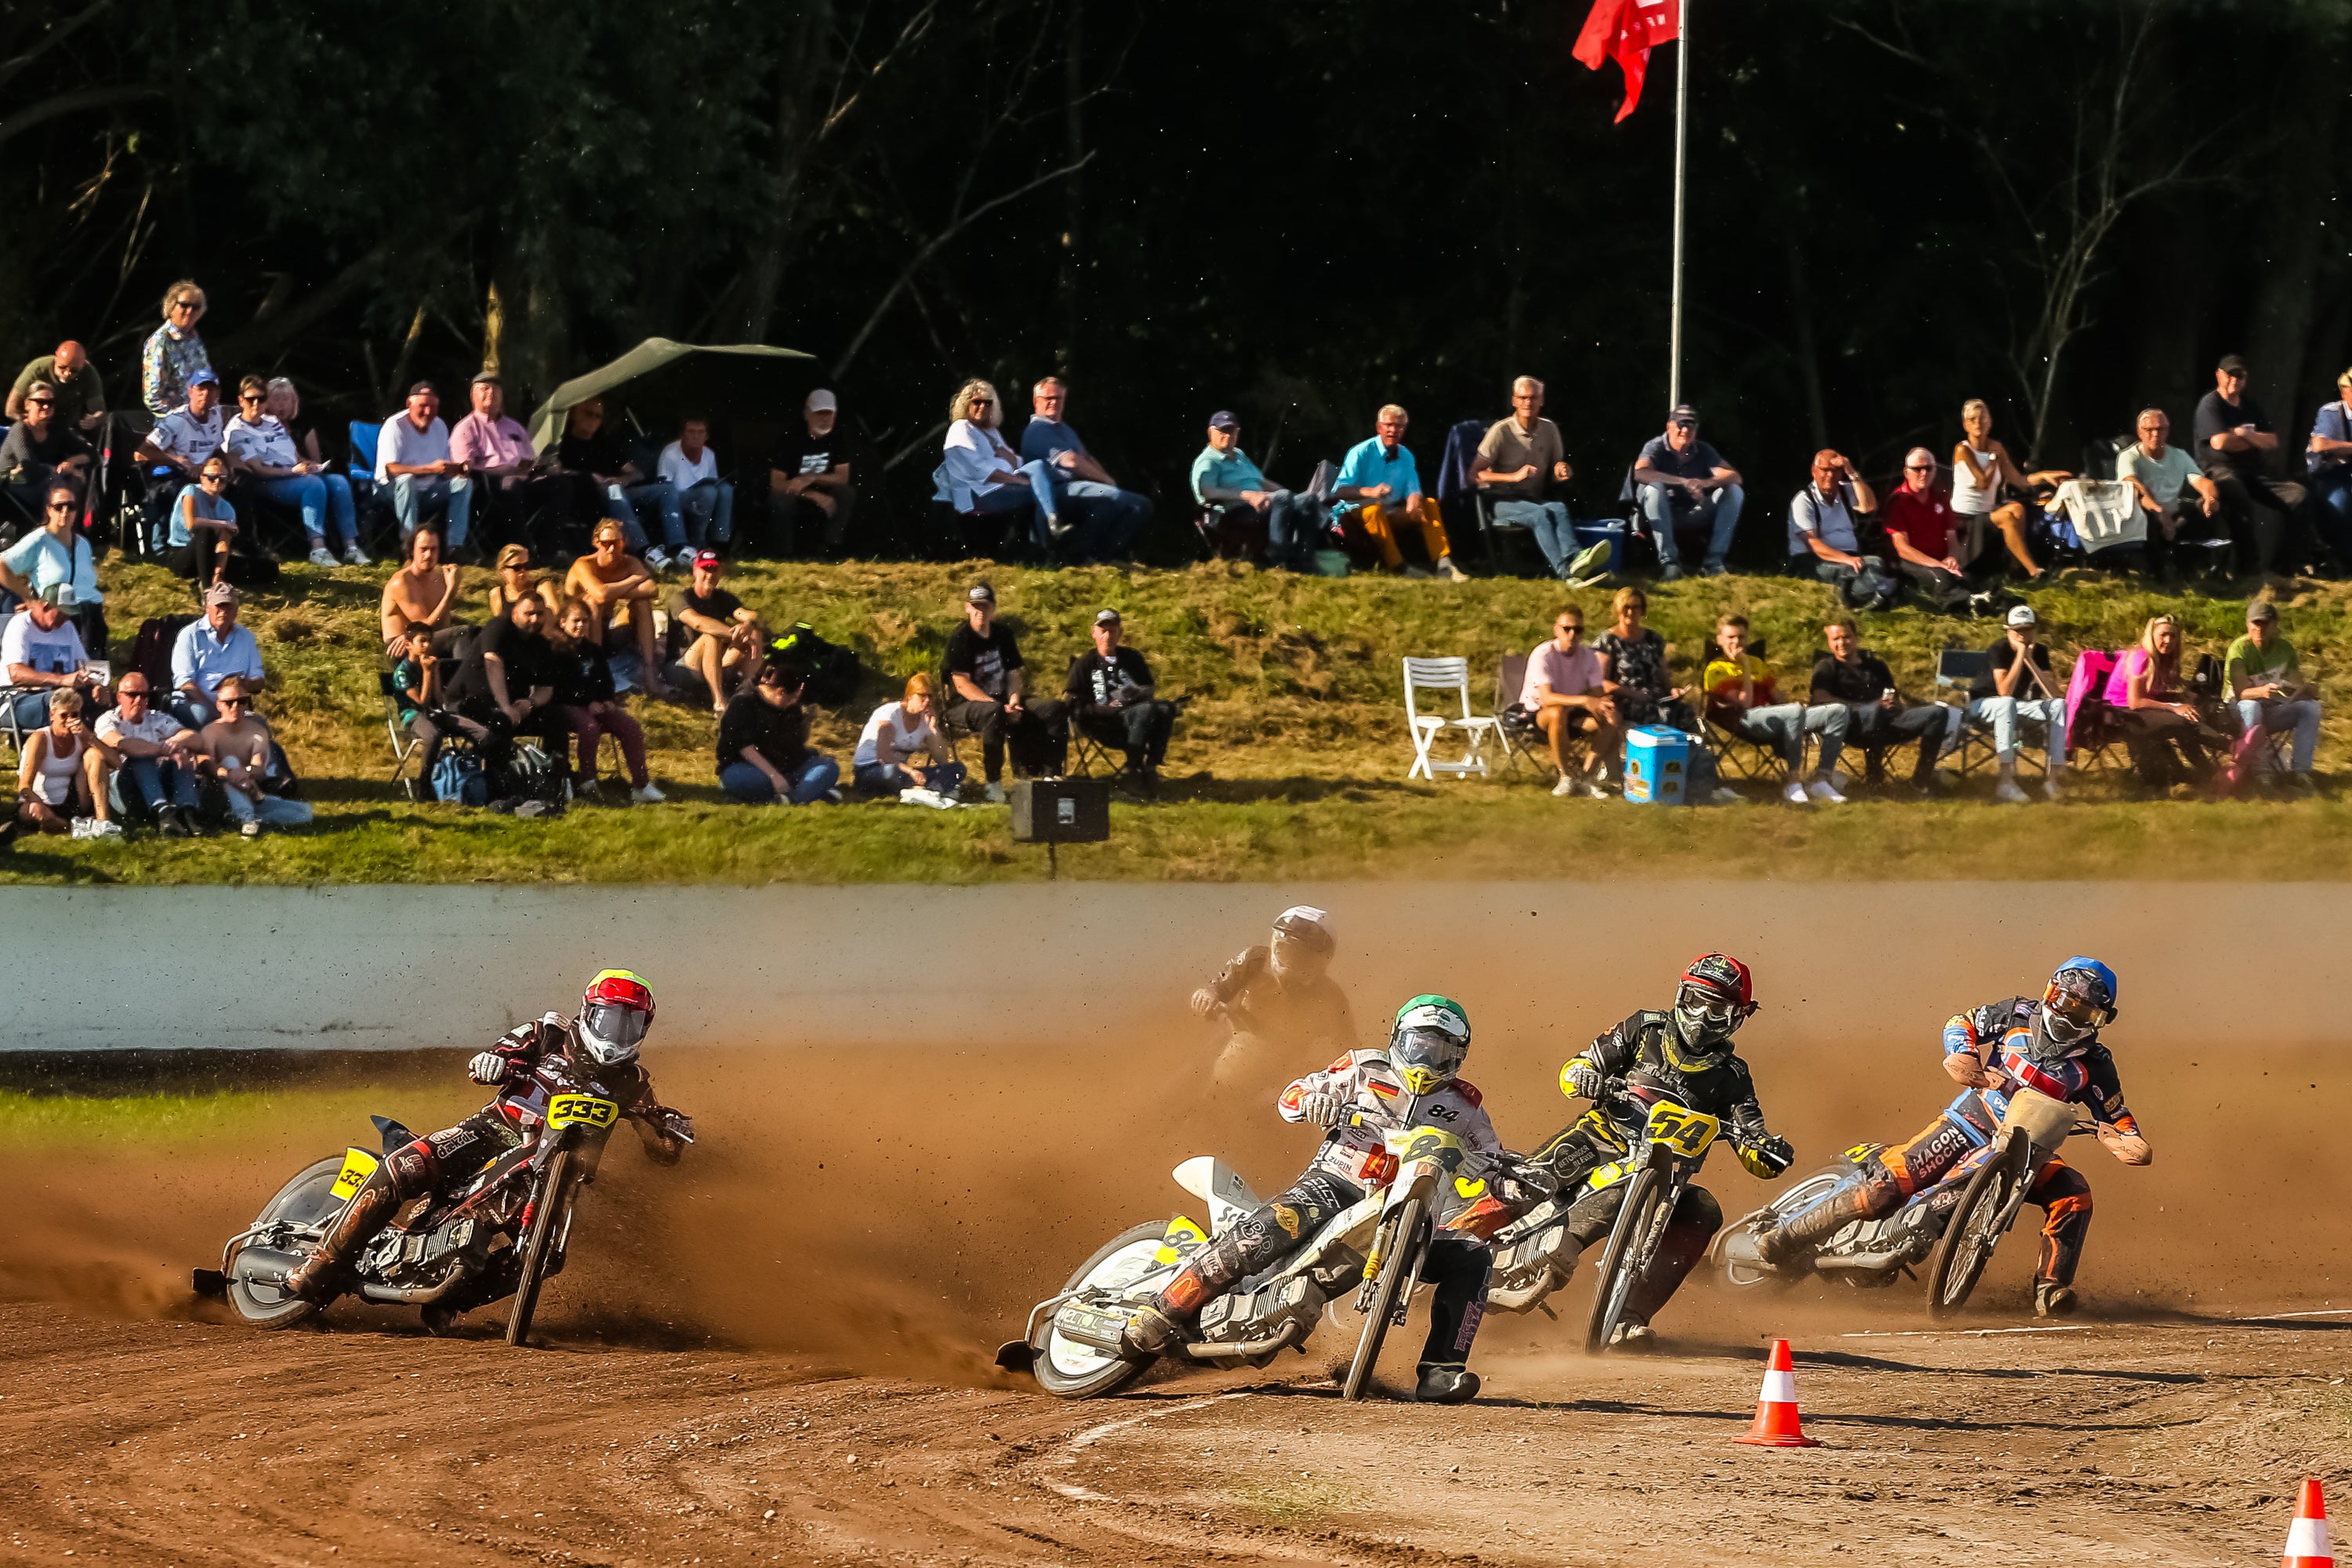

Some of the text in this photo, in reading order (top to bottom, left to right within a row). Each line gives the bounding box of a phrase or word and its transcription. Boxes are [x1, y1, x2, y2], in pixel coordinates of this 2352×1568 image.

[553, 1099, 613, 1124] 333
[1427, 1103, 1461, 1123] 84
[1646, 1110, 1711, 1152] 54
[1913, 1125, 1960, 1170] HAGON
[1328, 1156, 1352, 1172] ZUPIN
[1402, 1134, 1465, 1175] 84
[1918, 1134, 1967, 1178] SHOCKS
[1163, 1230, 1203, 1259] 84
